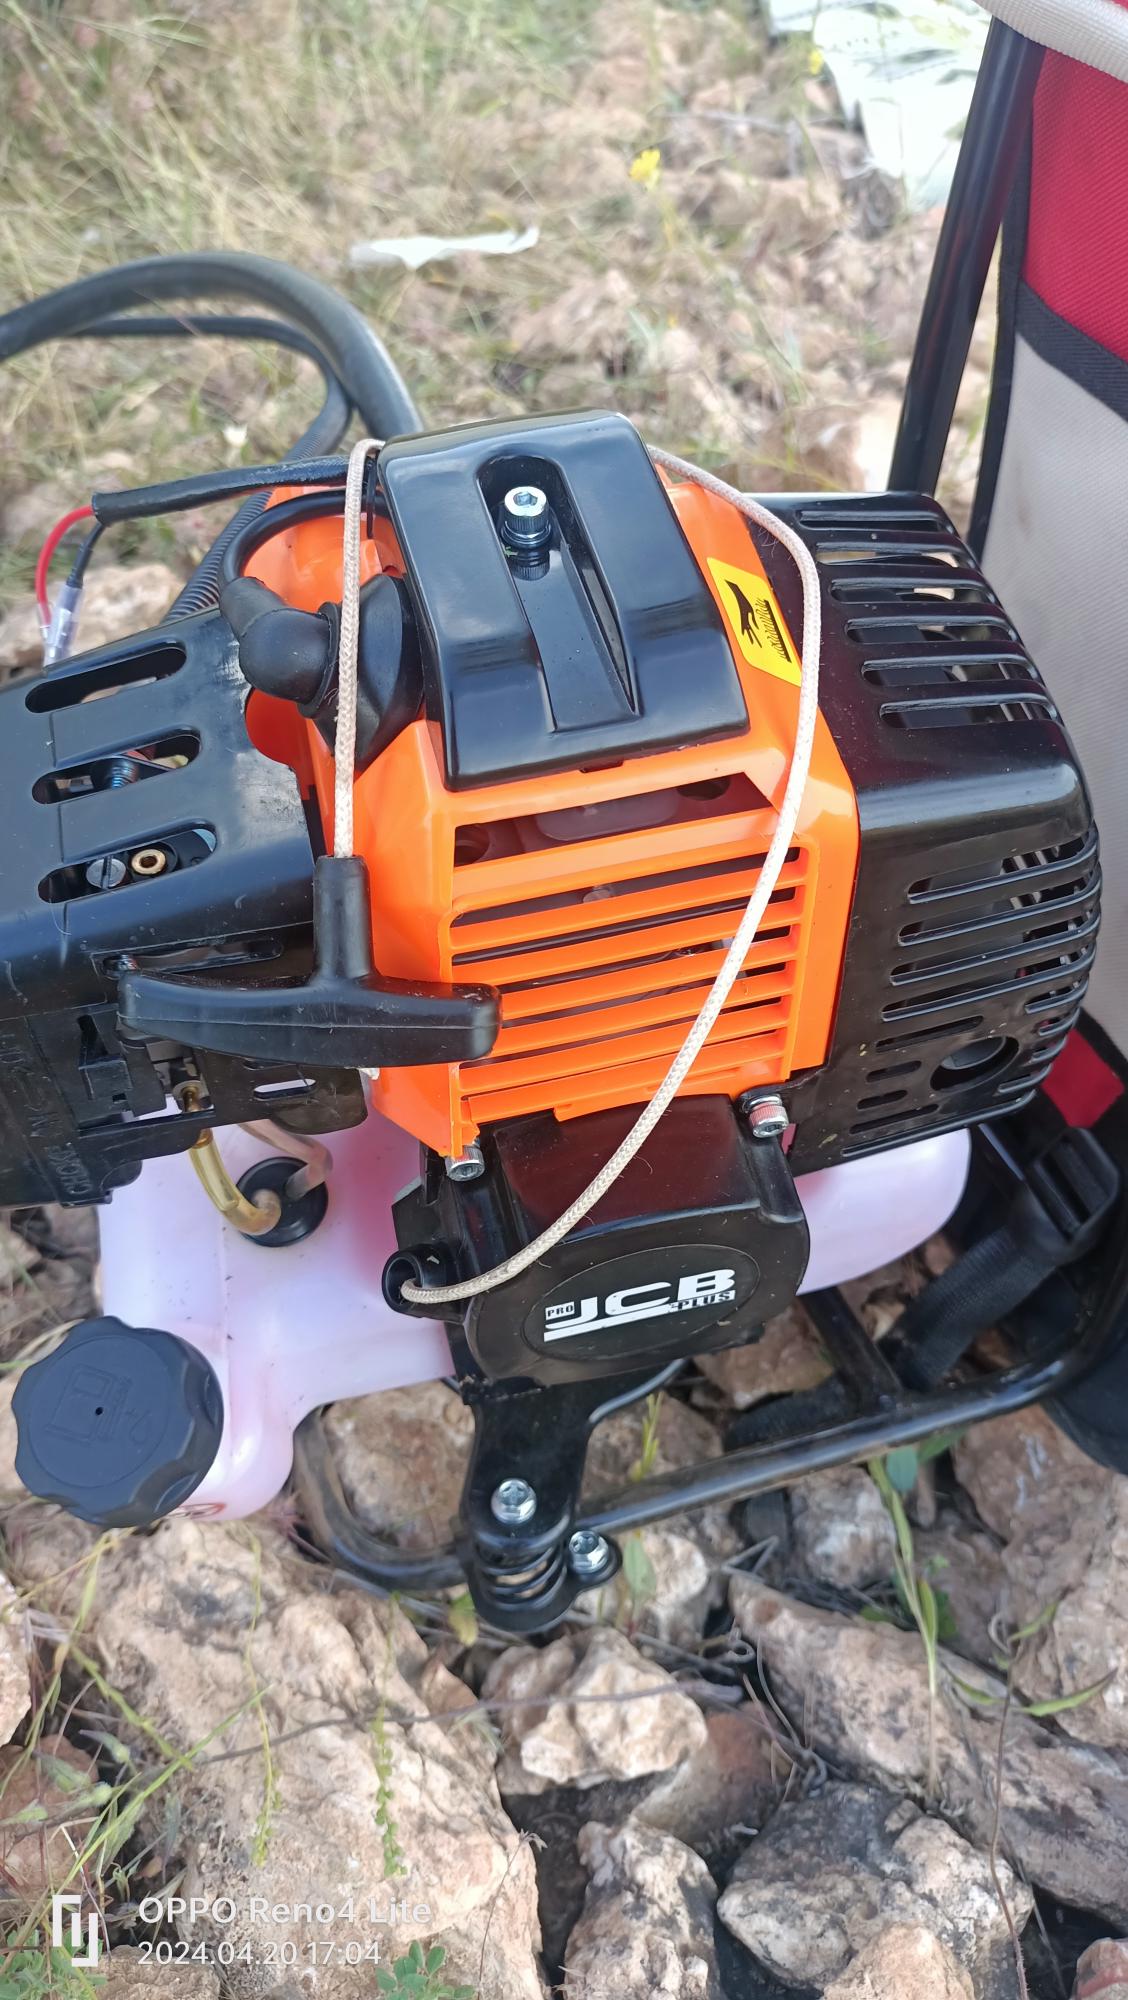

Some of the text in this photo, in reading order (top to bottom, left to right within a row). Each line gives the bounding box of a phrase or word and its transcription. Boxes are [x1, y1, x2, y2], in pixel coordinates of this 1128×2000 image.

[545, 1269, 736, 1329] JCB
[677, 1291, 733, 1311] PLUS
[547, 1303, 574, 1318] PRO
